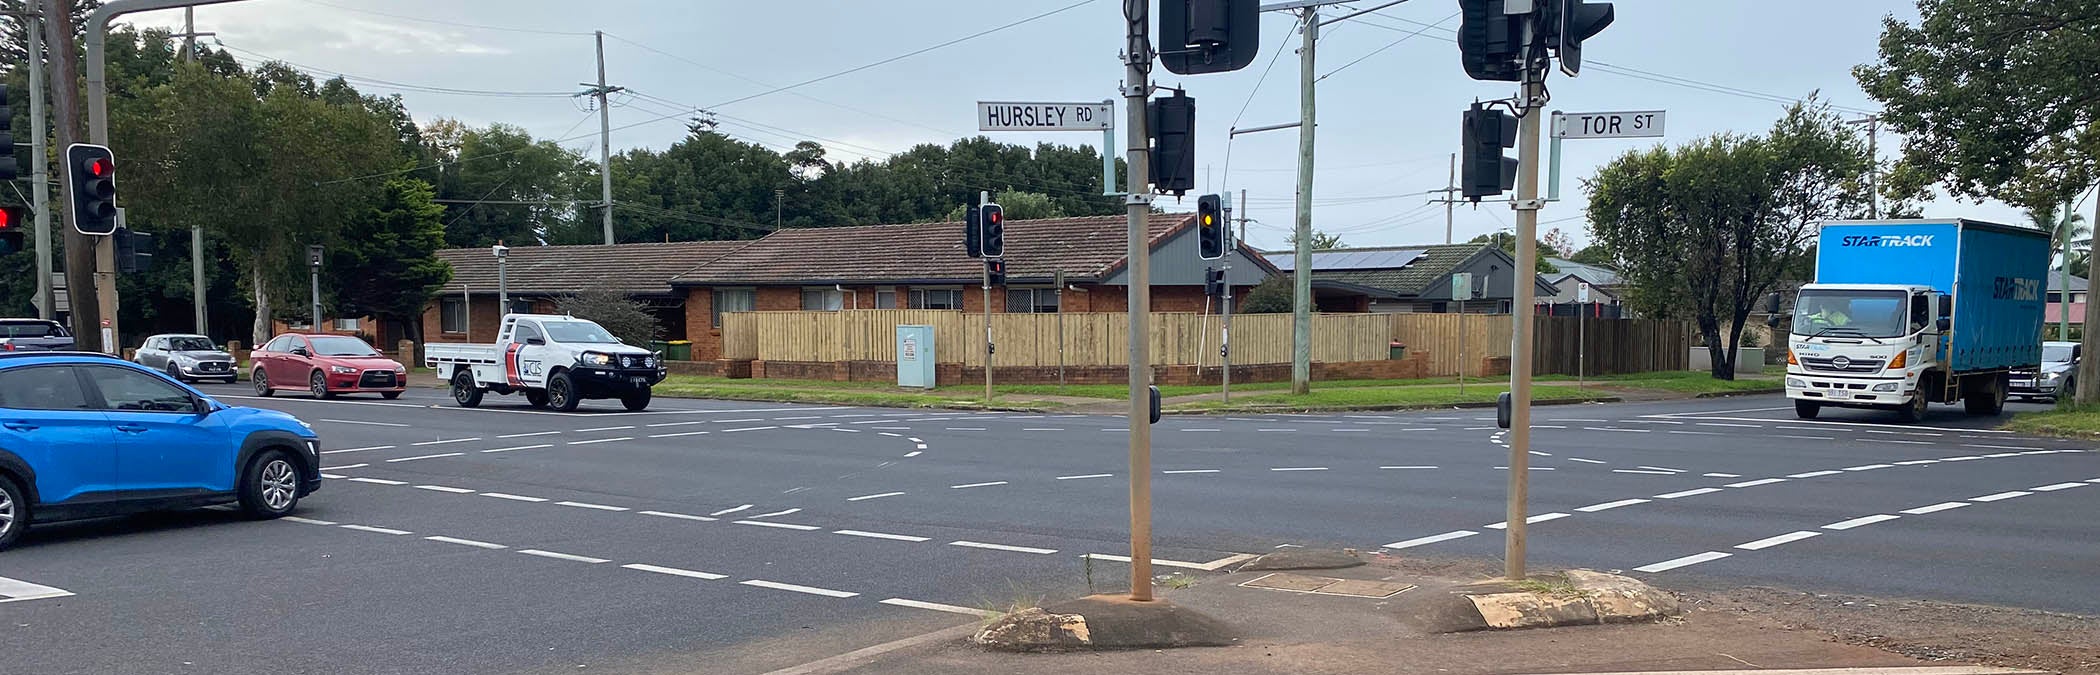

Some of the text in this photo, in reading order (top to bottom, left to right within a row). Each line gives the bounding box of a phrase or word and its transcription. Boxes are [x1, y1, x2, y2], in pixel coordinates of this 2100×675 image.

[988, 106, 1092, 126] HURSLEY RD
[1581, 115, 1654, 134] TOR ST
[1842, 235, 1935, 247] STARTRACK
[1993, 277, 2039, 300] STARTRACK
